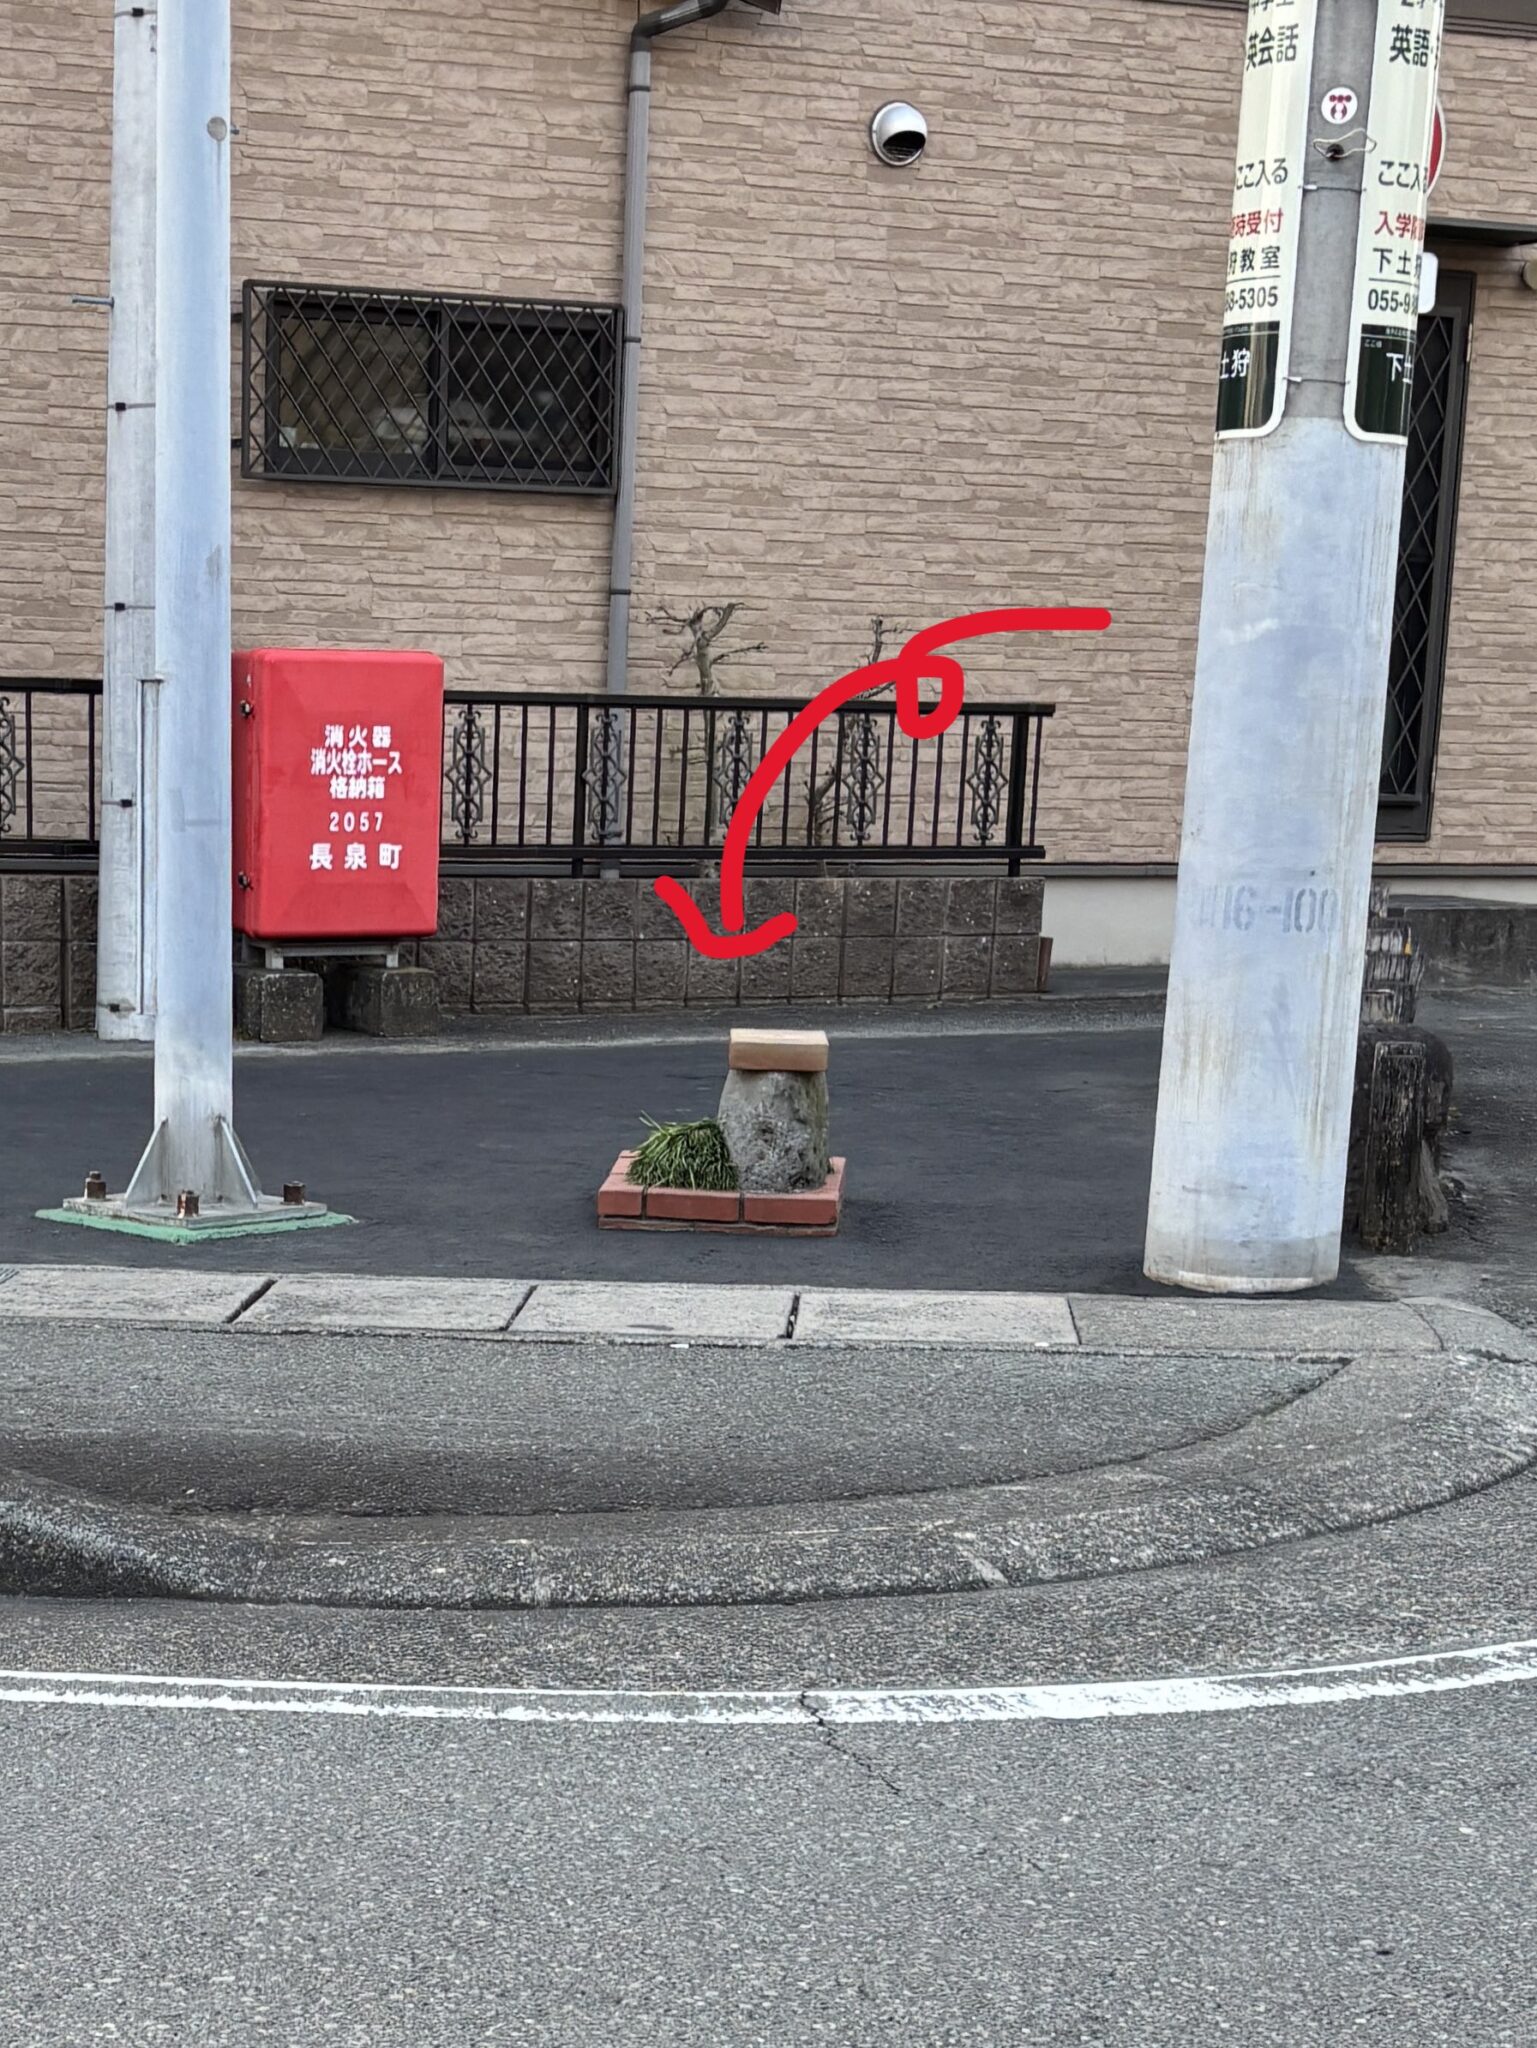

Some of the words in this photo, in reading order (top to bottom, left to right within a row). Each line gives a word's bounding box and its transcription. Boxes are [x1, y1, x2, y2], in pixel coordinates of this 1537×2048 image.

[1246, 23, 1299, 71] 英会話
[324, 724, 391, 748] 消火器
[311, 748, 402, 775] 消火栓ホース
[330, 776, 385, 799] 格納箱
[329, 811, 383, 832] 2057
[309, 843, 402, 870] 長泉町
